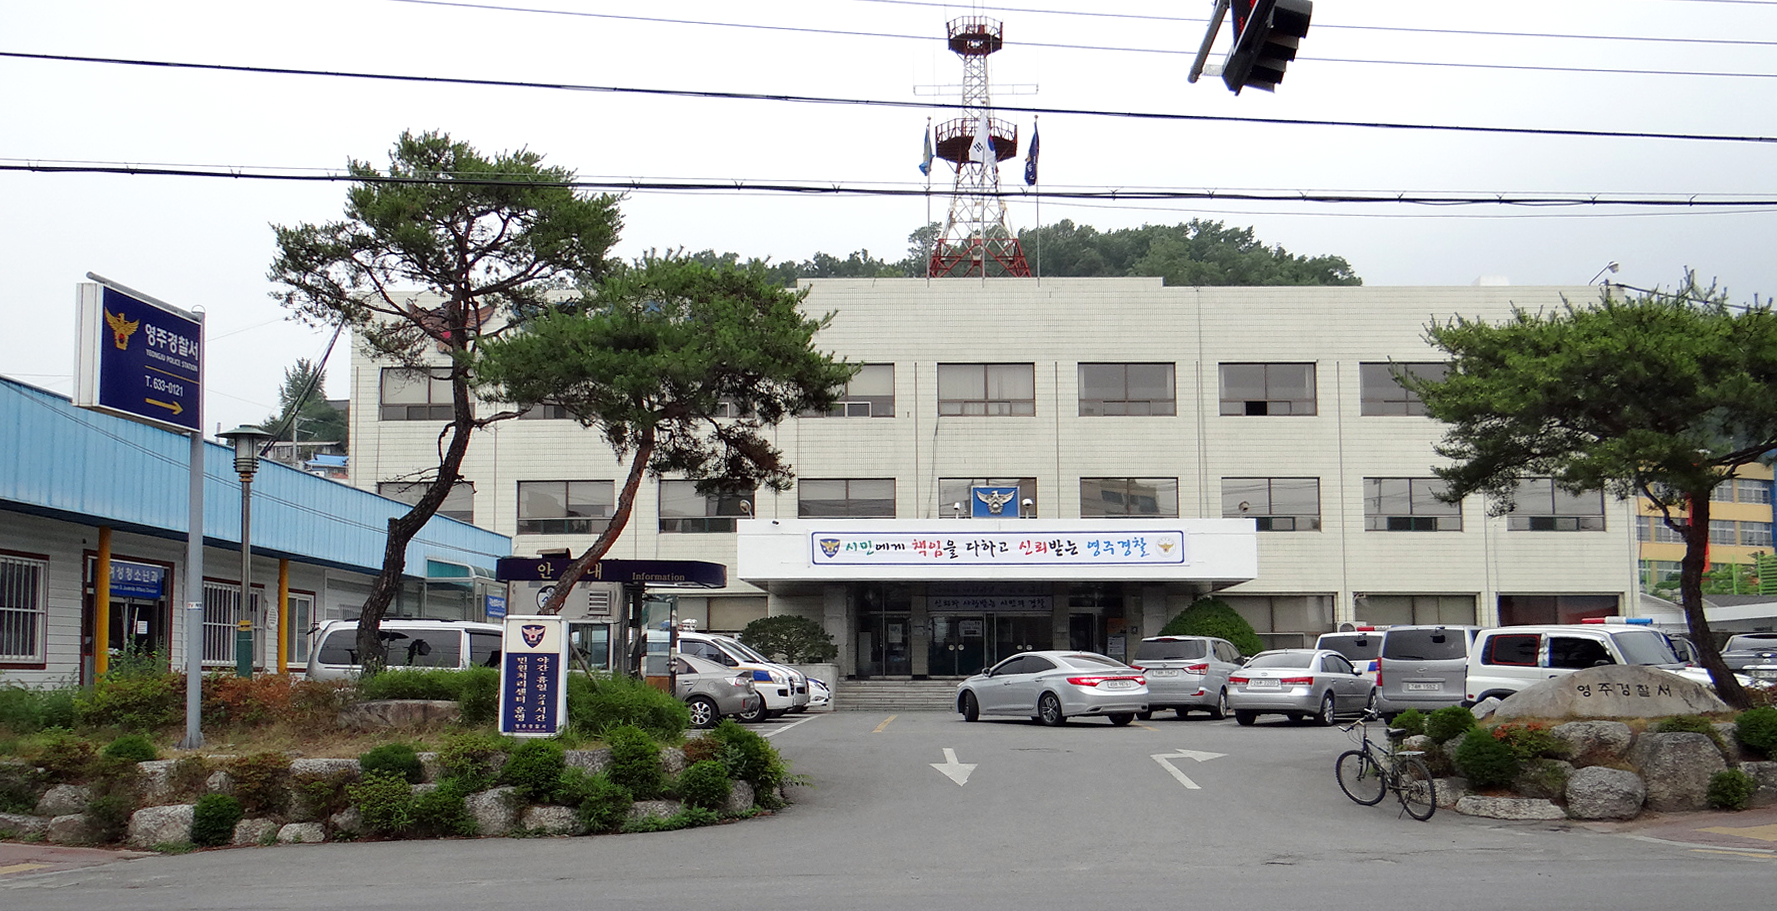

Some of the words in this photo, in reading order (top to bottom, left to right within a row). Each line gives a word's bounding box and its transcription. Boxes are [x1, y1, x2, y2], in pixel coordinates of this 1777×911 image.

[145, 323, 199, 361] 영주경찰서
[153, 377, 184, 397] 633-0121
[845, 539, 906, 556] 시민에게
[911, 538, 959, 560] 책임을
[965, 538, 1009, 558] 다하고
[1018, 539, 1080, 557] 신뢰받는
[1086, 536, 1151, 558] 영주경찰
[632, 571, 686, 582] Information
[1576, 682, 1672, 698] 영주경찰서
